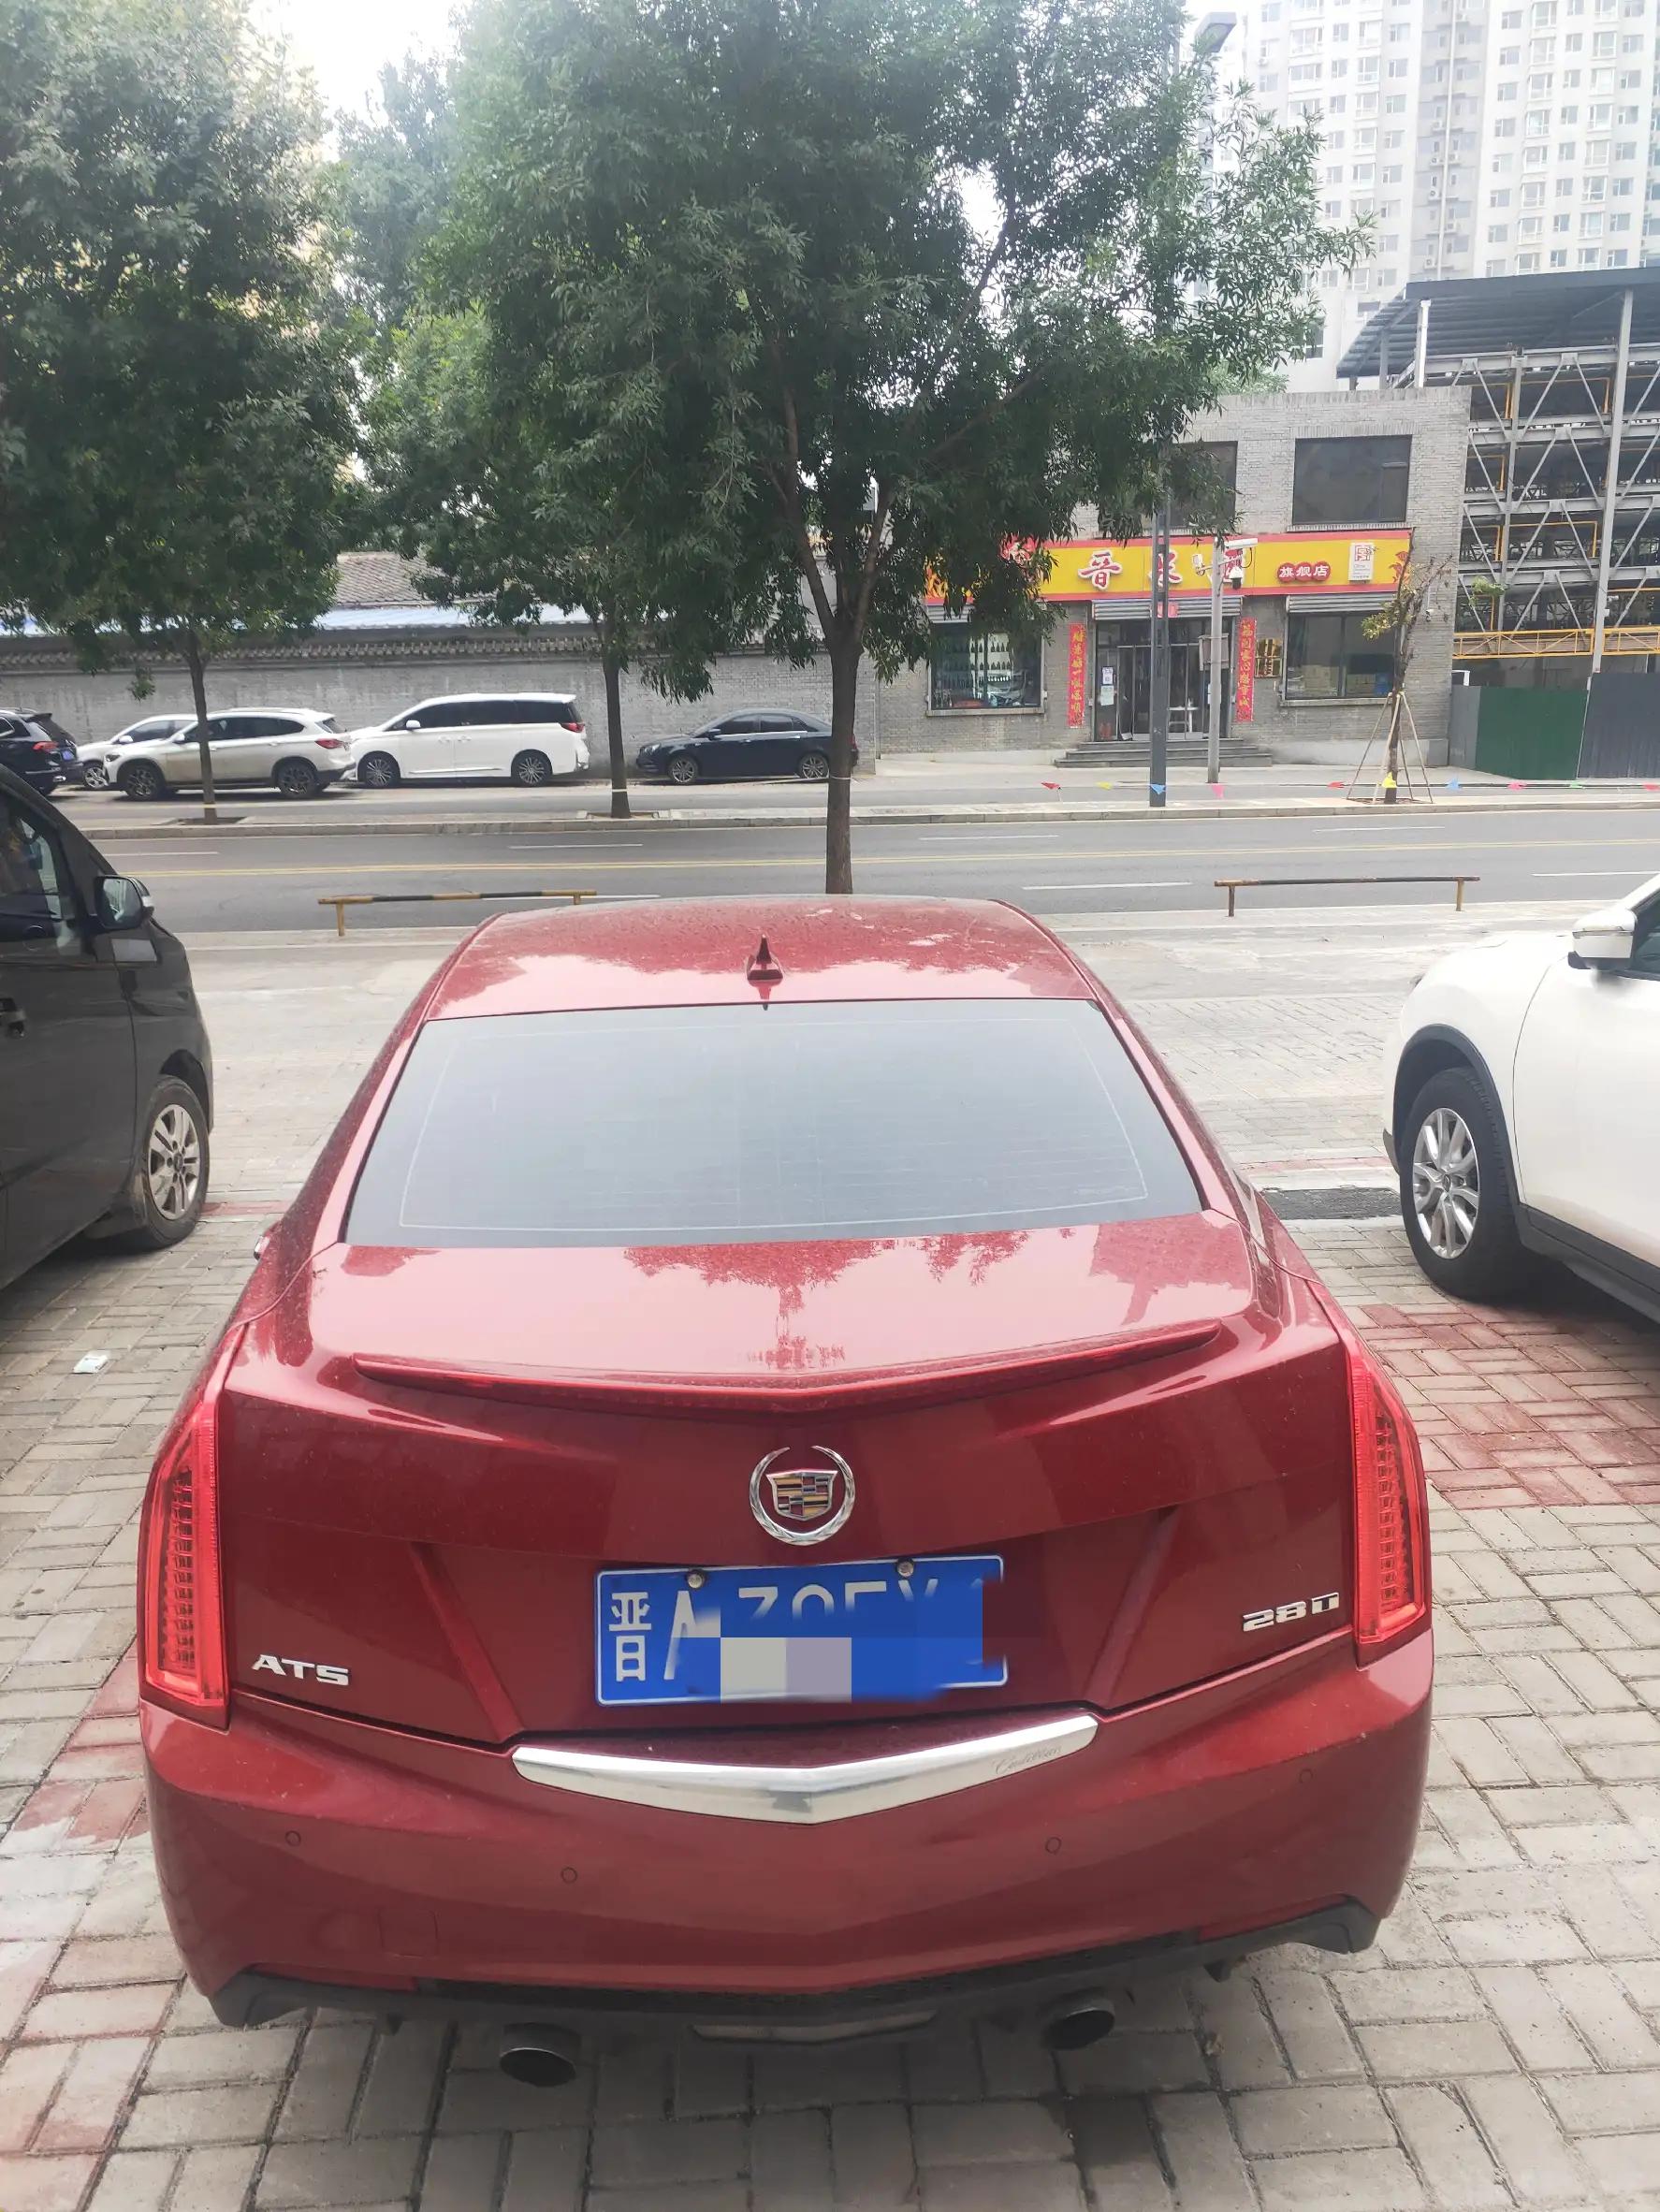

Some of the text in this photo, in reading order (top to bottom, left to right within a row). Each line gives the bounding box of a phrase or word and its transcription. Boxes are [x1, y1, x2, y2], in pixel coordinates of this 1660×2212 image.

[1278, 564, 1329, 578] 旗舰店
[252, 1653, 349, 1686] ATS
